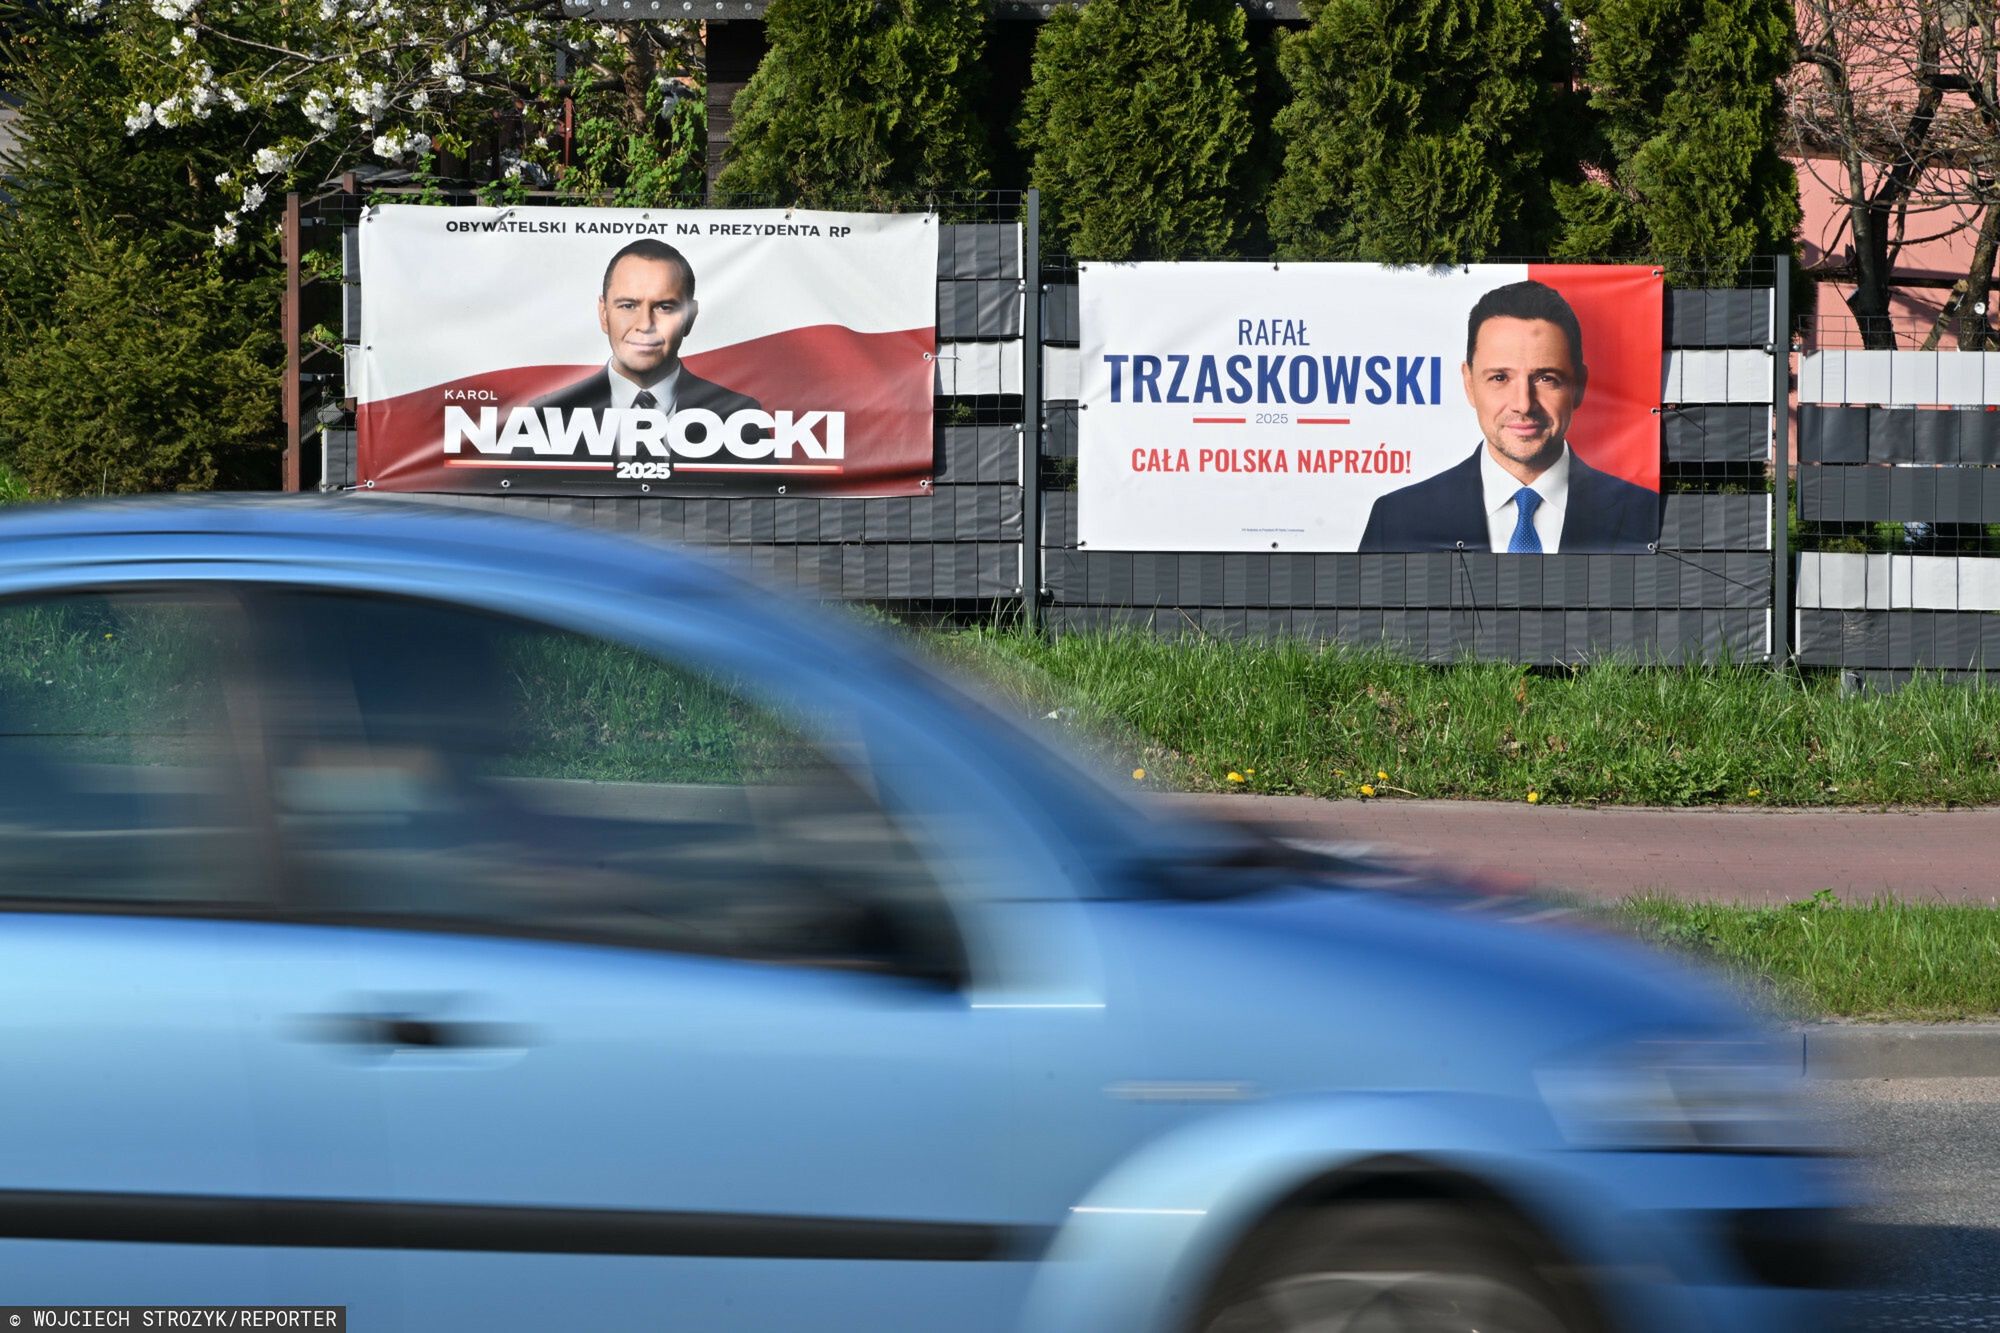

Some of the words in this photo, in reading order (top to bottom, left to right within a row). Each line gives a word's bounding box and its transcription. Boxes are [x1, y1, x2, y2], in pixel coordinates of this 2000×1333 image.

[445, 220, 567, 234] OBYWATELSKI
[574, 221, 669, 236] KANDYDAT
[675, 222, 701, 236] NA
[709, 223, 821, 238] PREZYDENTA
[828, 225, 852, 238] RP
[1238, 319, 1311, 346] RAFAŁ
[1103, 354, 1442, 406] TRZASKOWSKI
[444, 389, 498, 401] KAROL
[1255, 412, 1288, 425] 2025
[443, 406, 845, 460] NAWROCKI
[1131, 448, 1190, 474] CAŁA
[1199, 448, 1288, 474] POLSKA
[1297, 443, 1411, 474] NAPRZÓD!
[616, 461, 671, 480] 2025
